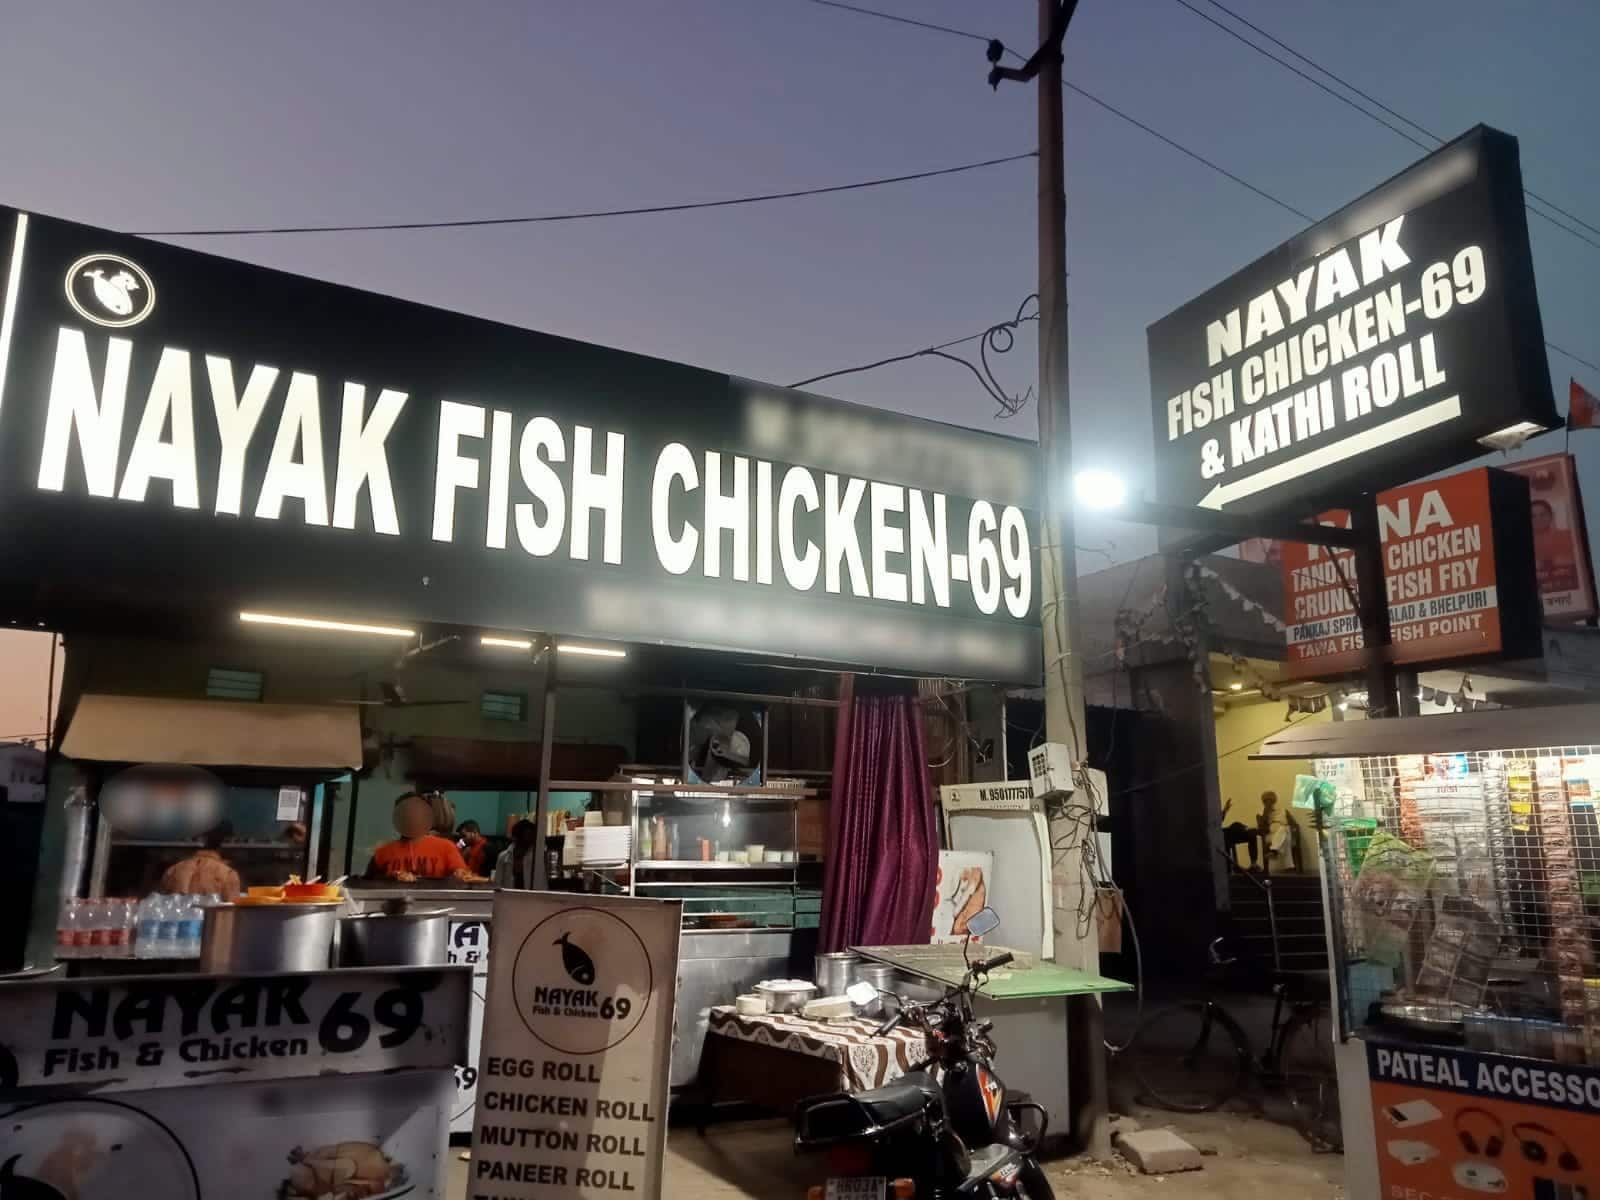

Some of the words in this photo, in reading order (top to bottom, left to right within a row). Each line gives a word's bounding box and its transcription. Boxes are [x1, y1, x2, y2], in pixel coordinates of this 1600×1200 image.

[1206, 215, 1412, 367] NAYAK
[1167, 374, 1235, 442] FISH
[1241, 245, 1487, 405] CHICKEN-69
[1201, 438, 1225, 479] &
[1230, 381, 1335, 468] KATHI
[1342, 333, 1446, 422] ROLL
[37, 327, 408, 535] NAYAK
[432, 400, 625, 564] FISH
[652, 442, 1032, 619] CHICKEN-69
[1388, 525, 1480, 570] CHICKEN
[1385, 568, 1432, 602] FISH
[1439, 557, 1480, 591] FRY
[1389, 605, 1415, 622] ALAD
[1419, 603, 1427, 617] &
[1431, 590, 1487, 616] BHELPURI
[1296, 640, 1338, 658] TAWA
[1342, 635, 1364, 652] FIS
[1430, 614, 1483, 636] POINT
[51, 978, 311, 1040] NAYAK
[318, 983, 425, 1053] 69
[534, 986, 598, 1007] NAYAK
[600, 996, 631, 1020] 69
[43, 1044, 119, 1077] Fish
[136, 1042, 163, 1066] &
[179, 1033, 308, 1062] Chicken
[487, 1056, 534, 1078] EGG
[542, 1062, 601, 1083] ROLL
[1377, 1050, 1468, 1088] PATEAL
[484, 1091, 588, 1117] CHICKEN
[596, 1100, 655, 1122] ROLL
[480, 1125, 578, 1151] MUTTON
[586, 1133, 645, 1157] ROLL
[477, 1160, 568, 1186] PANEER
[575, 1168, 635, 1192] ROLL
